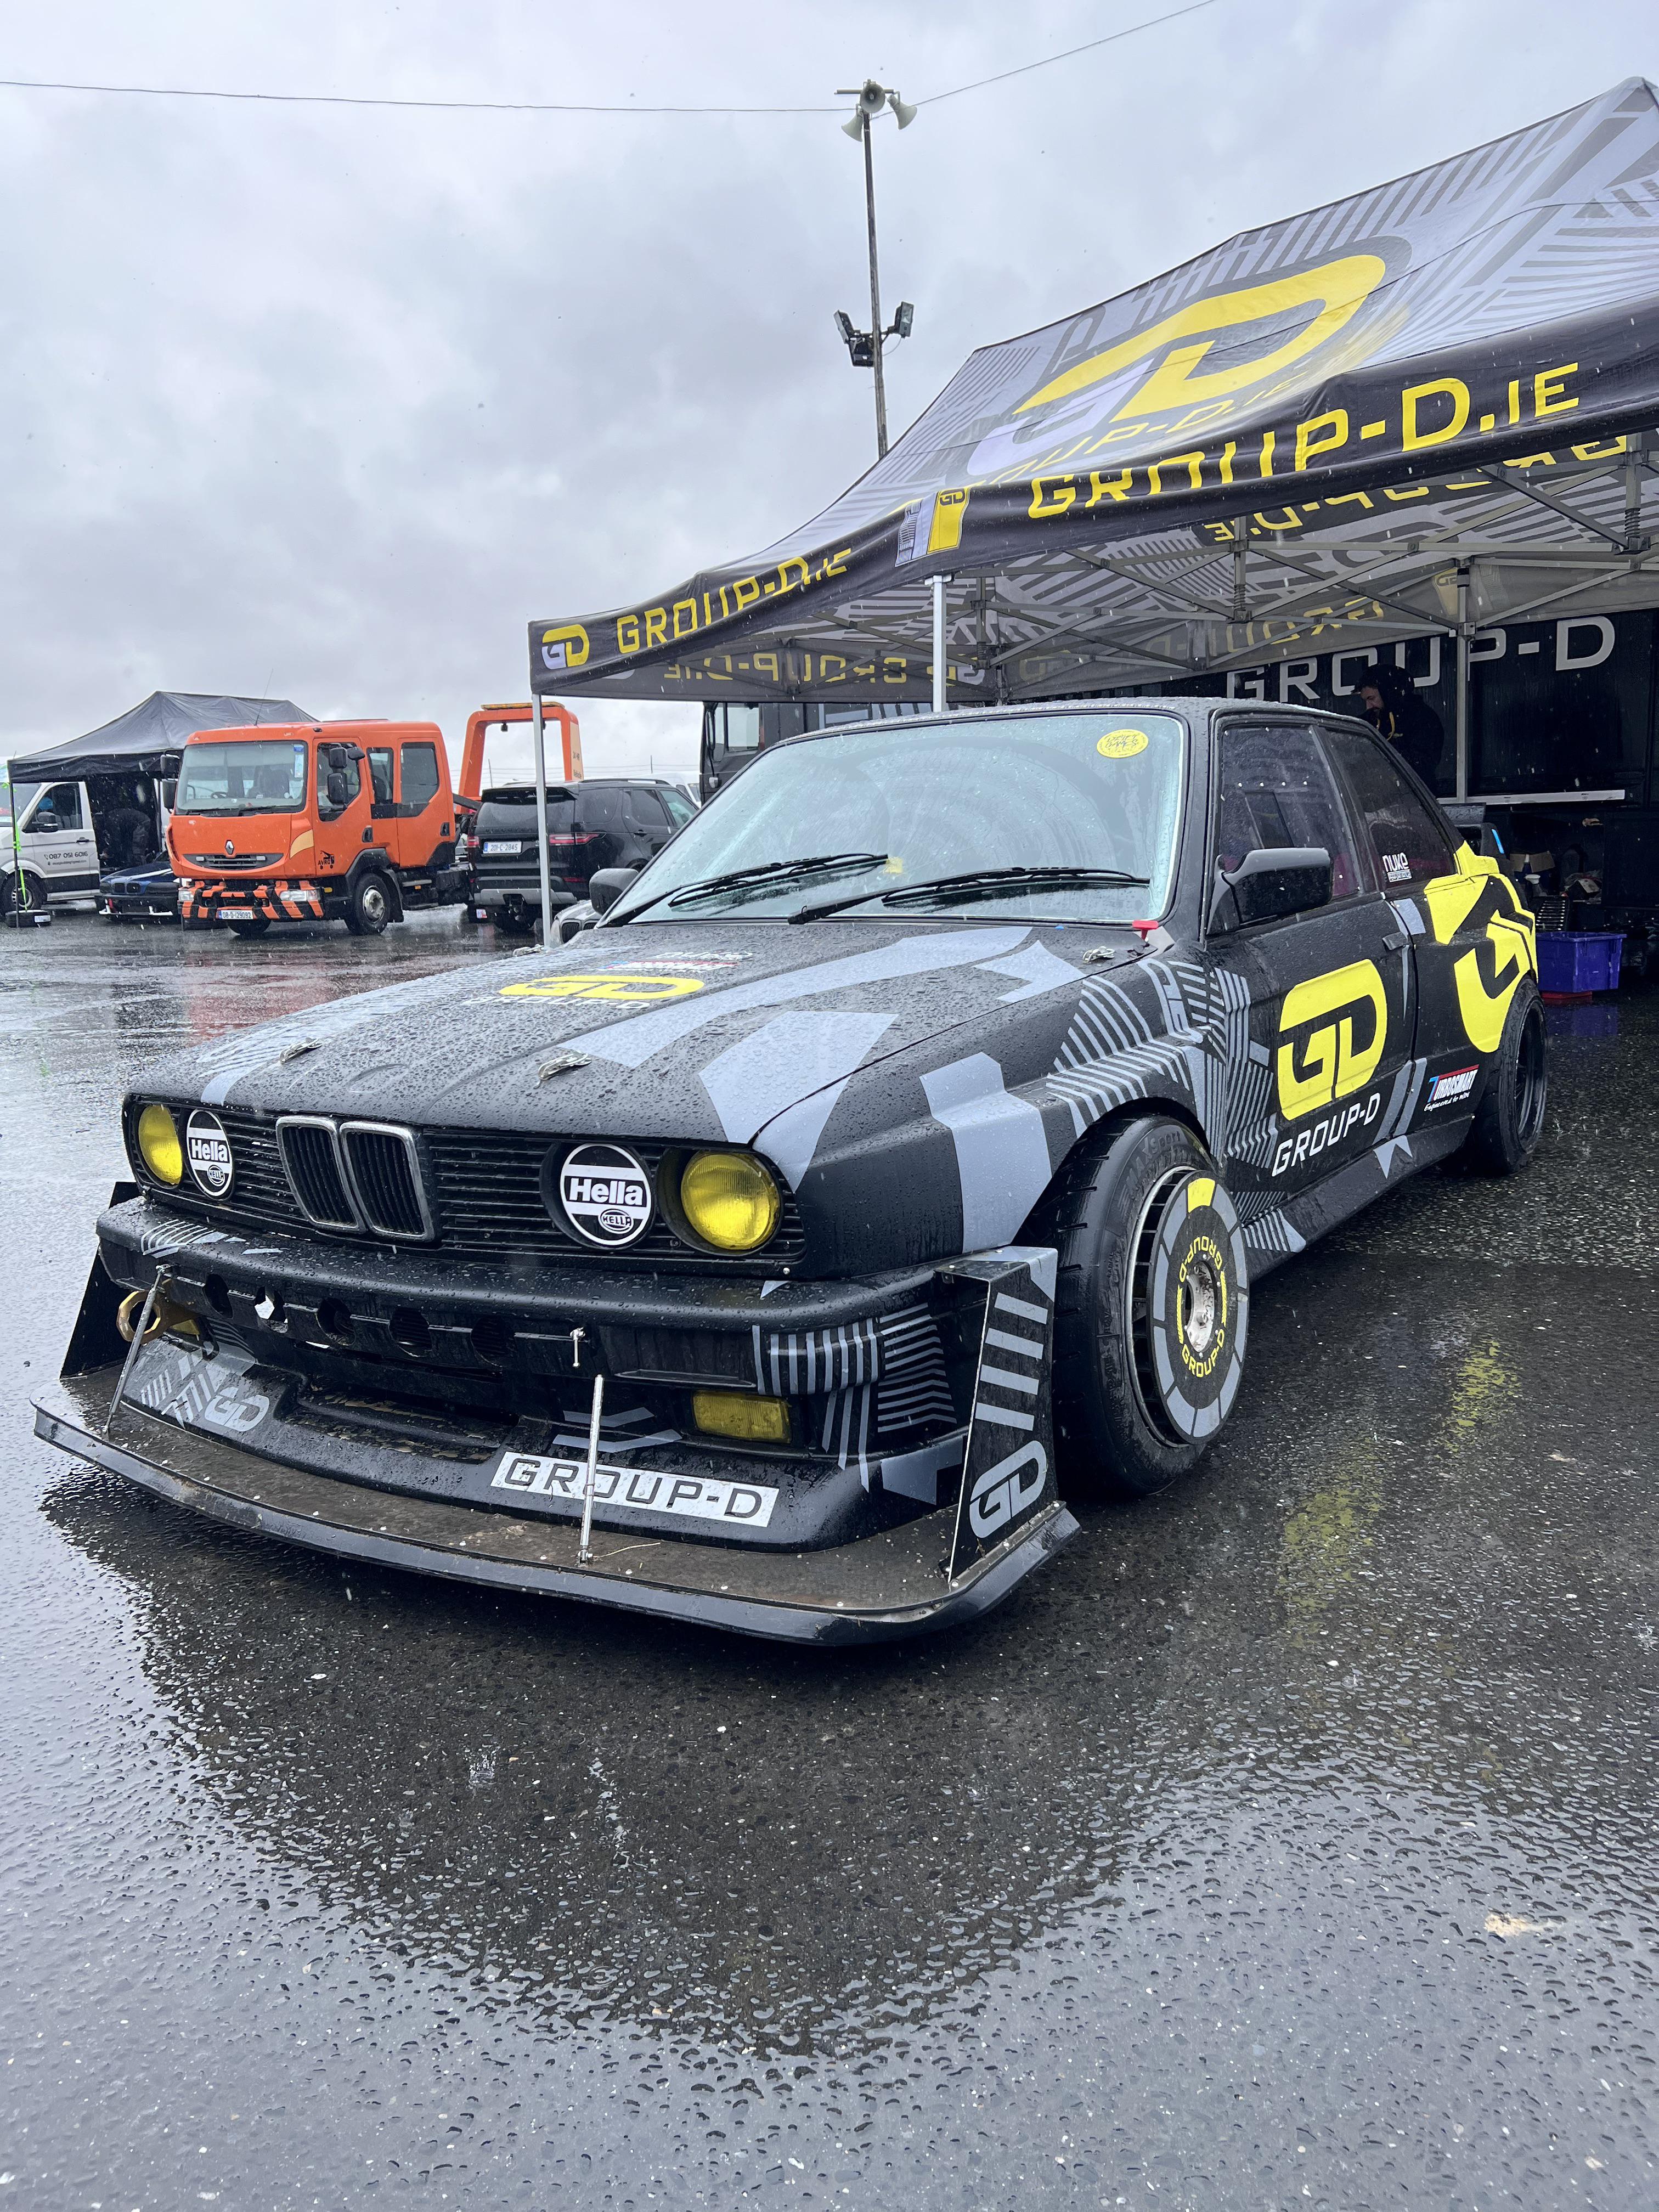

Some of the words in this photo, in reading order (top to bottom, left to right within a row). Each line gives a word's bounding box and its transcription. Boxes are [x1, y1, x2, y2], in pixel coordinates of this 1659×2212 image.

[1226, 616, 1616, 703] GROUP-D
[464, 996, 651, 1009] GROUP-D
[191, 1139, 228, 1162] Hella
[1271, 1092, 1381, 1178] GROUP-D
[569, 1177, 644, 1206] Hella
[602, 1215, 633, 1228] HELLA
[1180, 1235, 1223, 1283] GROUP-D
[1182, 1328, 1224, 1378] GROUP-D
[504, 1458, 763, 1519] GROUP-D
